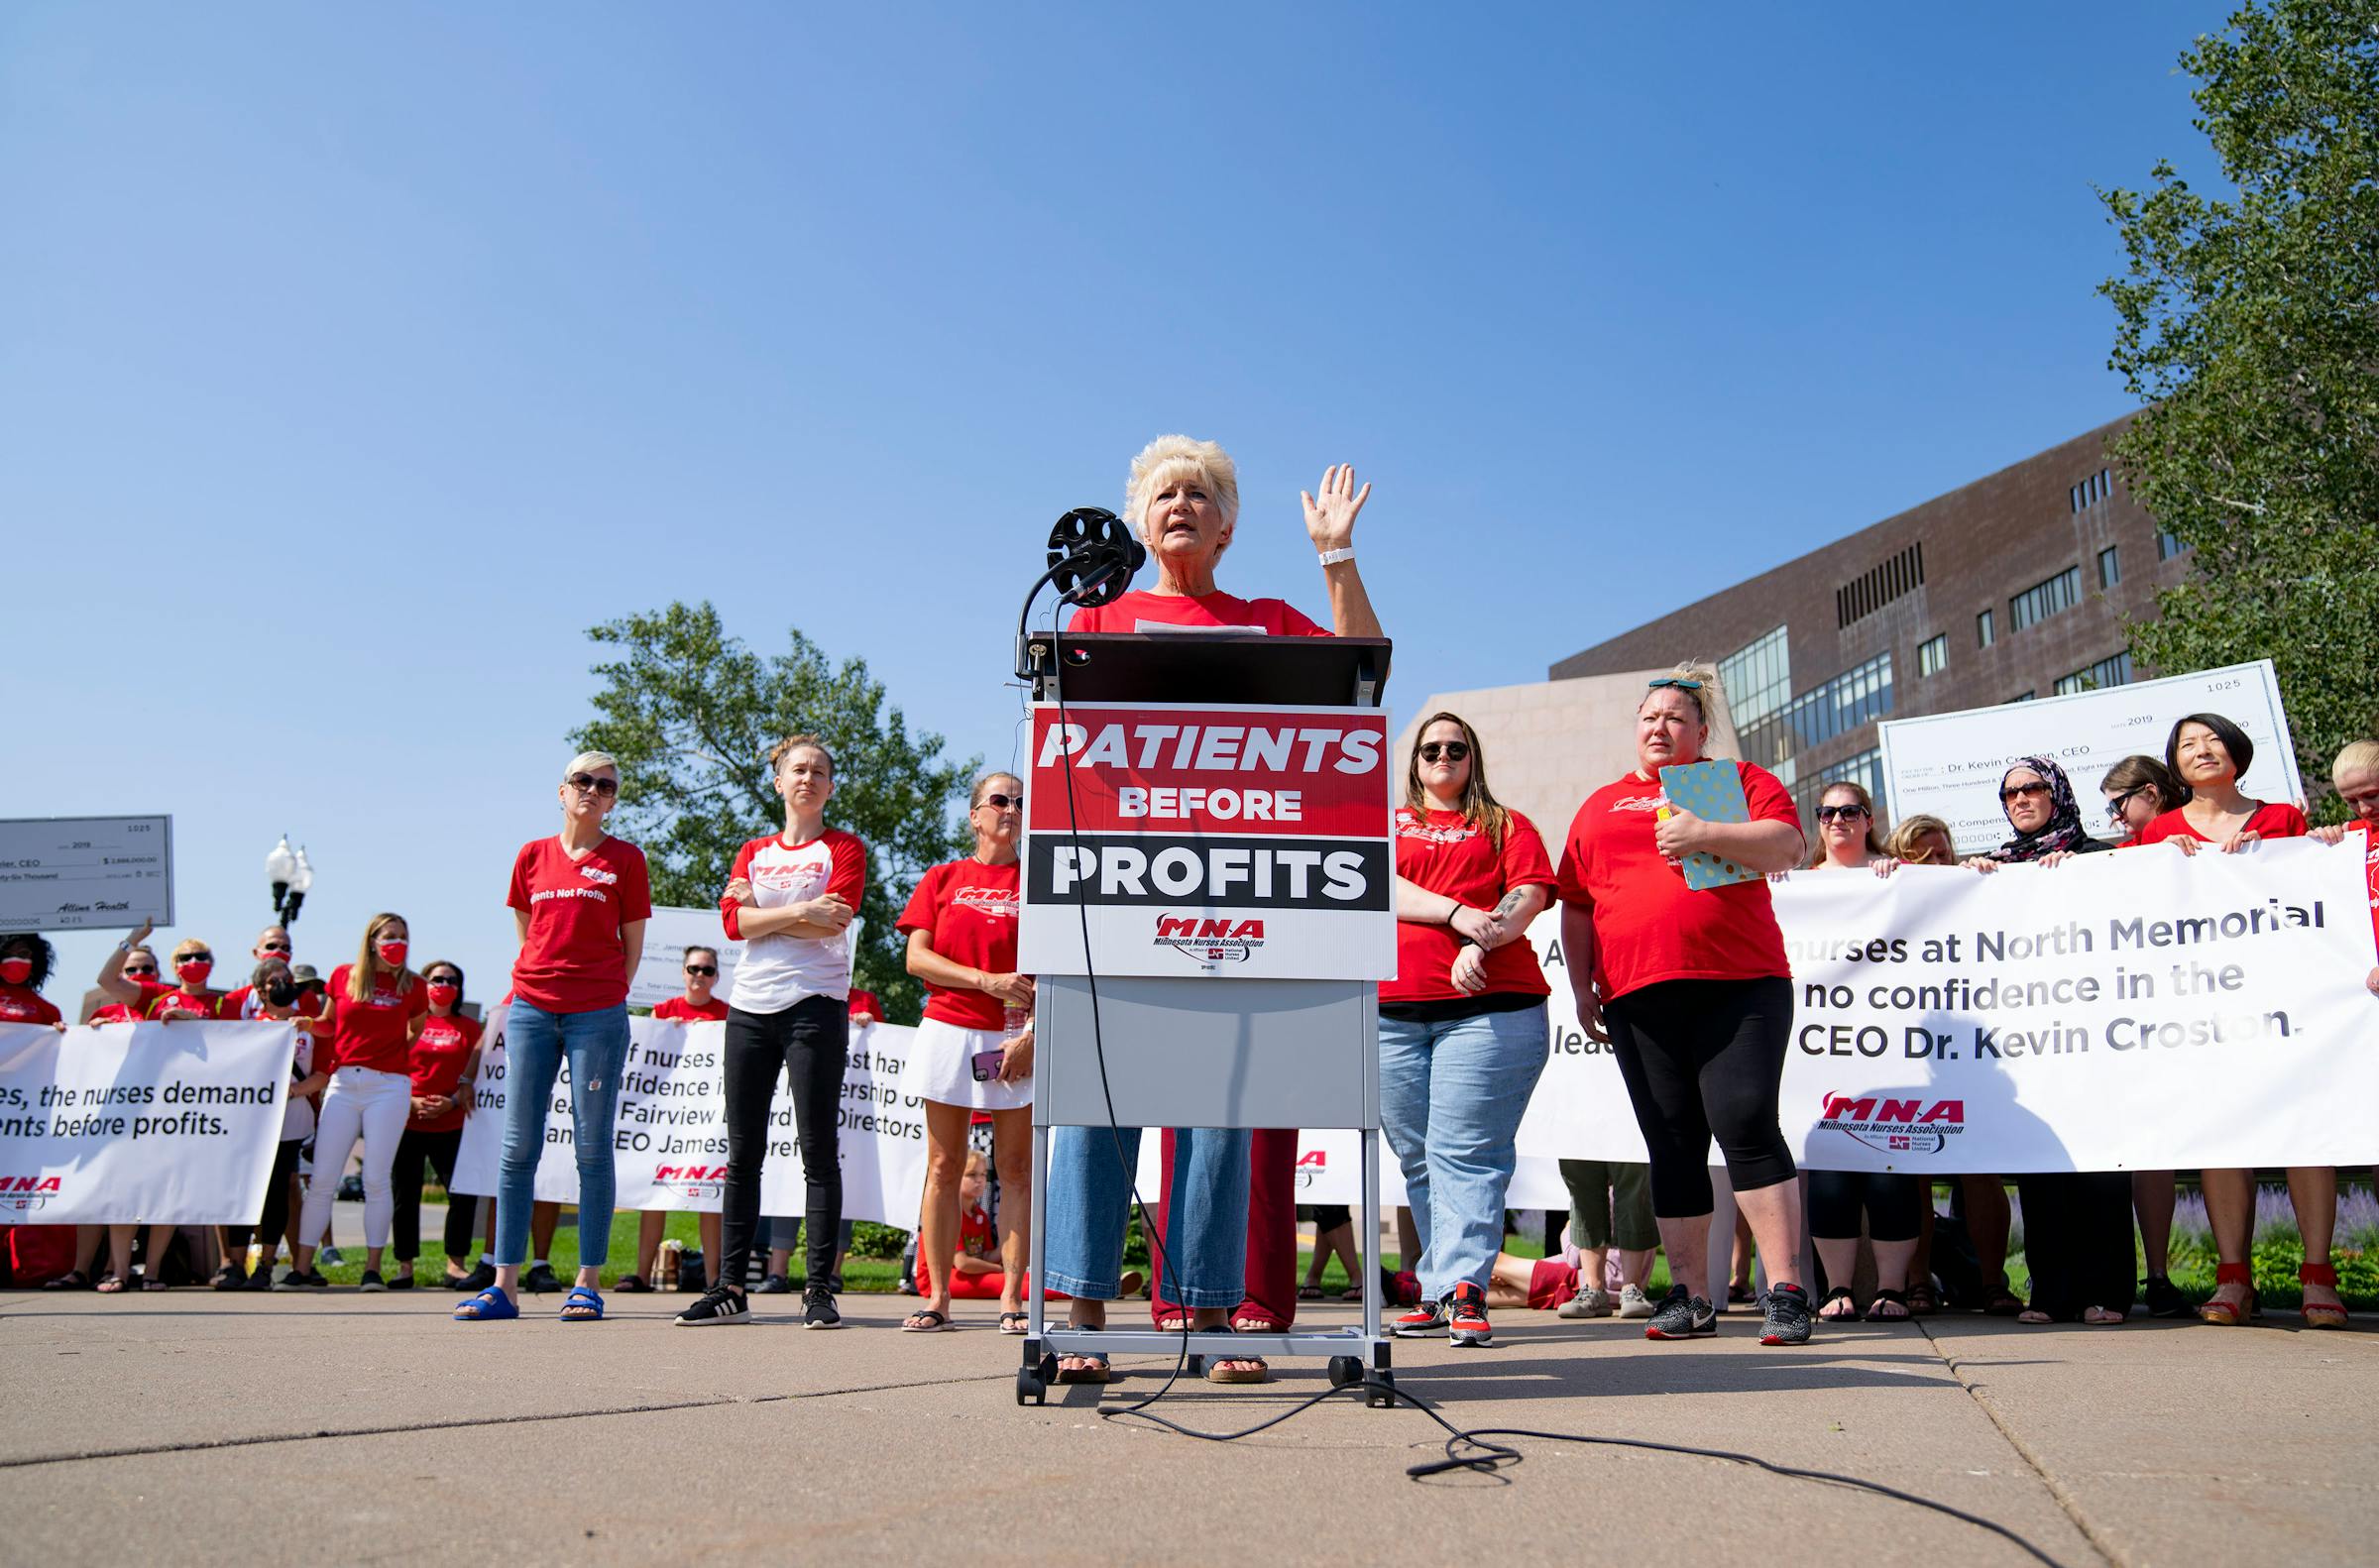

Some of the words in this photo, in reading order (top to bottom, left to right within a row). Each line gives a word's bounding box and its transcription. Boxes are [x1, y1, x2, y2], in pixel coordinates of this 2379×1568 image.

[2207, 679, 2241, 693] 1025
[2127, 715, 2153, 726] 2019
[1037, 723, 1384, 774] PATIENTS
[1948, 763, 1965, 772] Dr.
[1968, 758, 2002, 769] Kevin
[2062, 745, 2090, 756] CEO
[1118, 787, 1302, 821] BEFORE
[1959, 818, 2006, 828] Compens
[19, 859, 41, 868] CEO
[1052, 845, 1367, 901] PROFITS
[557, 888, 575, 898] Not
[577, 887, 607, 903] Profits
[1157, 918, 1265, 939] MNA
[1786, 938, 1908, 963] nurses
[1921, 934, 1962, 963] at
[1977, 921, 2093, 962] North
[2109, 898, 2324, 951] Memorial
[1153, 937, 1192, 946] Minnesota
[1192, 938, 1220, 947] Nurses
[1219, 938, 1265, 948] Association
[1805, 983, 1854, 1009] no
[1869, 976, 2099, 1011] confidence
[2116, 966, 2154, 1000] in
[2170, 960, 2245, 996] the
[1799, 1024, 1888, 1058] CEO
[1904, 1027, 1959, 1060] Dr.
[1975, 1021, 2090, 1060] Kevin
[2105, 1010, 2305, 1052] Croston.
[644, 1049, 715, 1068] nurses
[41, 1085, 76, 1106] the
[83, 1085, 155, 1106] nurses
[164, 1080, 276, 1105] demand
[477, 1089, 506, 1109] the
[621, 1100, 716, 1126] Fairview
[1823, 1097, 1964, 1123] MNA
[53, 1113, 125, 1137] before
[133, 1111, 229, 1141] profits.
[1817, 1120, 1869, 1132] Minnesota
[1869, 1122, 1904, 1133] Nurses
[1904, 1123, 1964, 1135] Association
[614, 1129, 650, 1152] EO
[658, 1134, 729, 1154] James
